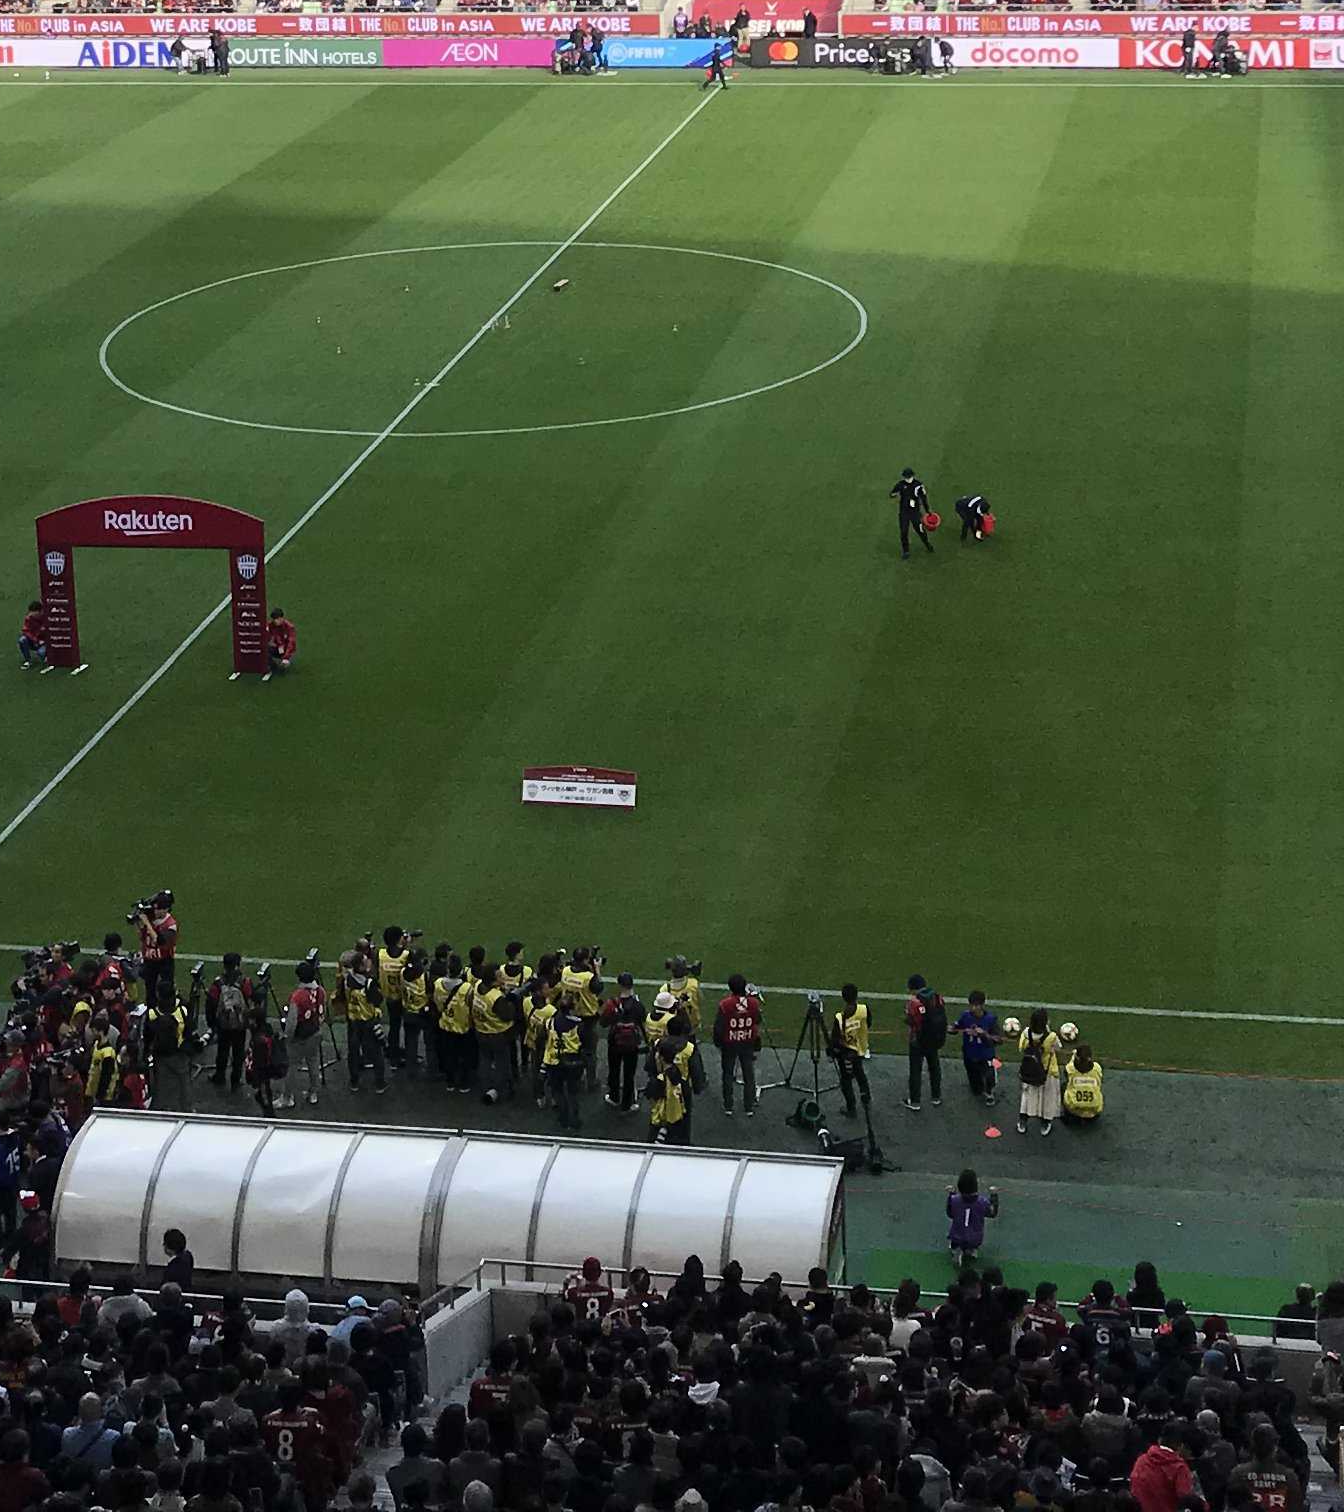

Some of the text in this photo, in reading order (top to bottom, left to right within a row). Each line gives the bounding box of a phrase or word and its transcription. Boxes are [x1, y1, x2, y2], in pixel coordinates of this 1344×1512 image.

[40, 19, 70, 34] CLUB
[74, 19, 85, 34] in
[90, 19, 125, 34] ASIA
[151, 19, 256, 34] WE ARE KOBE
[360, 18, 382, 33] THE
[408, 18, 437, 33] CLUB
[441, 18, 455, 33] in
[459, 18, 495, 33] ASIA
[521, 18, 546, 33] WE
[956, 17, 980, 32] THE
[1007, 17, 1040, 32] CLUB
[1044, 17, 1059, 32] in
[1062, 17, 1101, 32] ASIA
[1131, 17, 1157, 32] WE
[1202, 17, 1251, 32] KOBE
[322, 53, 377, 65] HOTELS
[971, 42, 1079, 63] docomo
[104, 509, 193, 531] Rakuten
